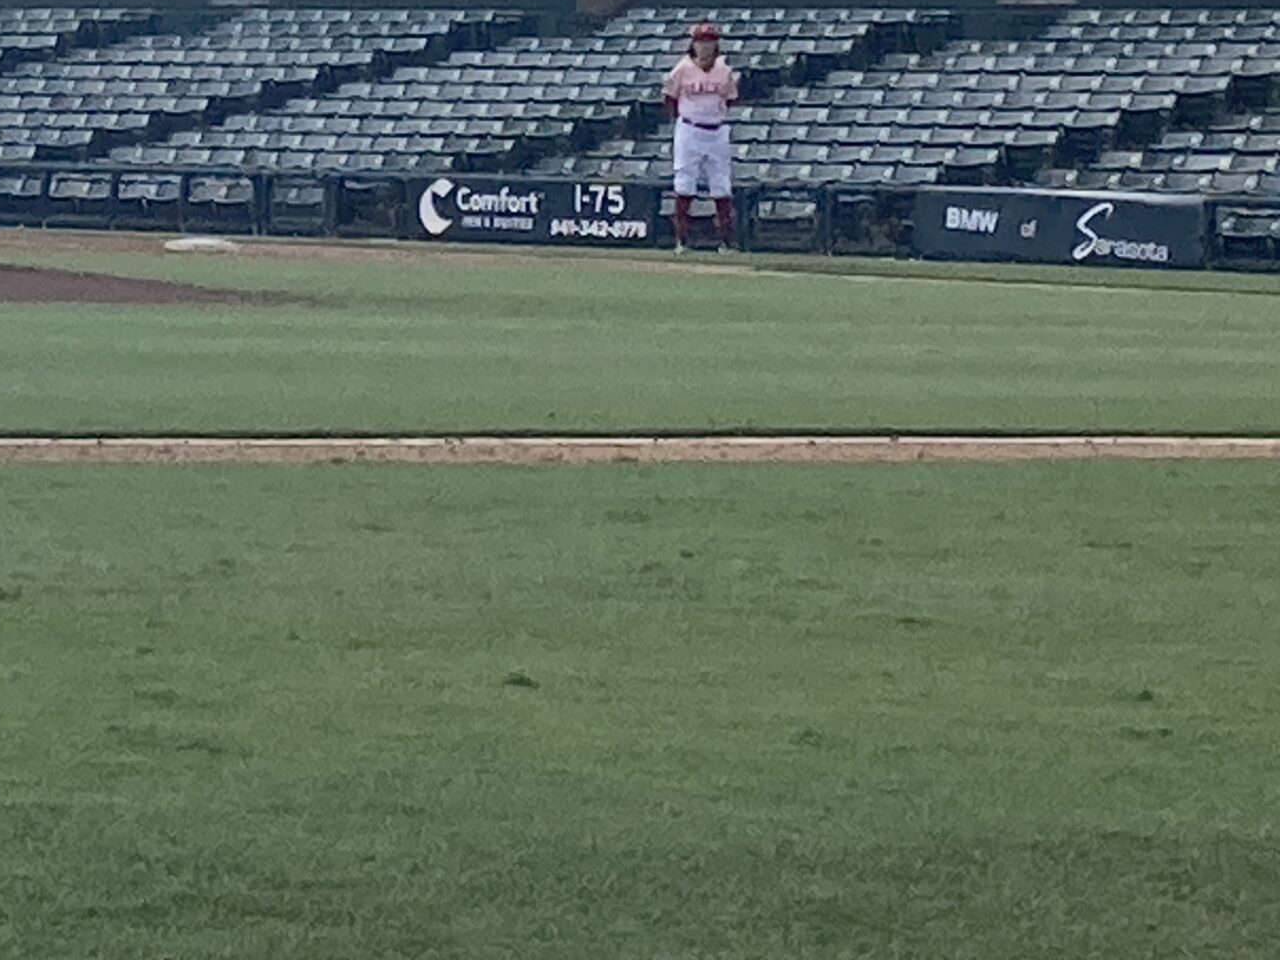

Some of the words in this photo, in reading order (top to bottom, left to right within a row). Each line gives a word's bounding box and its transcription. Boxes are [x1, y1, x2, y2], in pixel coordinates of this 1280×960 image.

[456, 186, 540, 214] Comfort
[575, 183, 625, 215] I-75
[945, 206, 1000, 235] BMW
[1072, 202, 1169, 261] Sarasota
